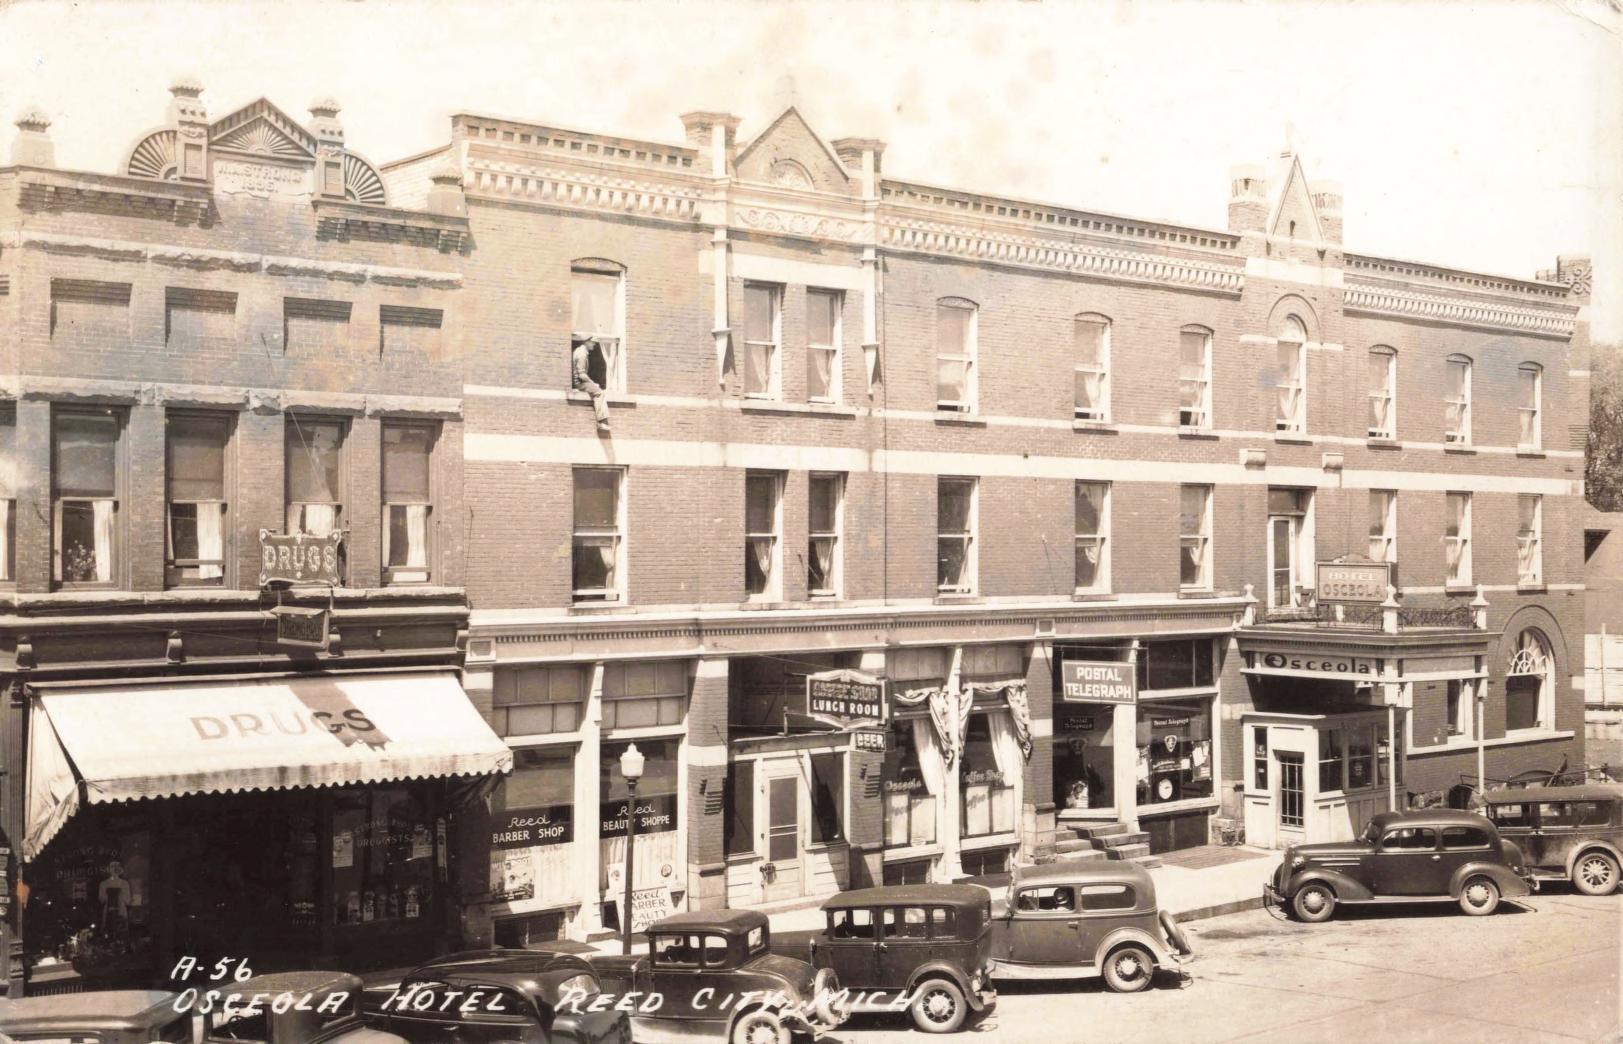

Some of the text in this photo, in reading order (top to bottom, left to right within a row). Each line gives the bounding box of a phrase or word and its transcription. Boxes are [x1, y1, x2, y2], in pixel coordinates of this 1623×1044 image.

[263, 545, 335, 573] DRUGS
[1328, 571, 1376, 581] HOTEL
[1323, 583, 1384, 598] OSCEOLA
[1264, 652, 1370, 674] Osceola
[1076, 666, 1122, 682] POSTAL
[1065, 682, 1132, 699] TELEGRAPH
[813, 699, 879, 716] LUNCH ROOM
[190, 709, 377, 741] DRUGS
[857, 733, 885, 748] BEER
[617, 804, 656, 817] Red
[508, 814, 551, 829] Reed
[603, 815, 671, 832] BEAUT SHOPPE
[492, 826, 565, 843] BARBER SHOP
